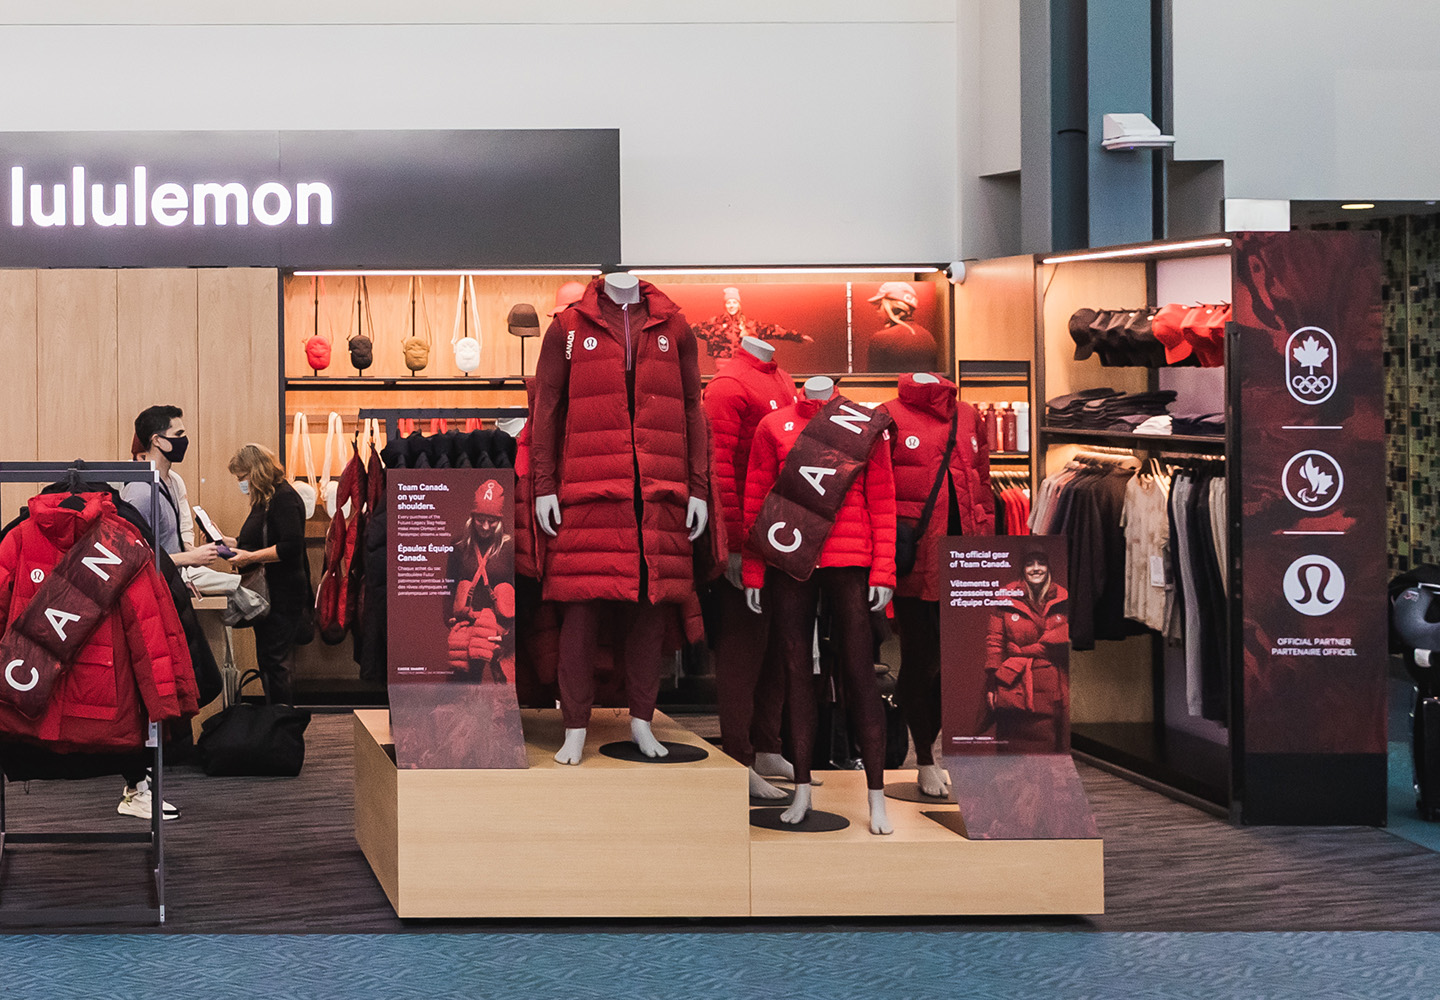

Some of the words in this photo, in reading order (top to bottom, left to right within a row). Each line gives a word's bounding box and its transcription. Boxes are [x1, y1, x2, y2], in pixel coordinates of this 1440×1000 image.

[11, 165, 333, 227] lululemon
[565, 330, 576, 360] CANADA
[767, 404, 872, 553] CAN
[397, 483, 418, 491] Team
[419, 483, 450, 492] Canada,
[408, 494, 426, 502] your
[397, 502, 436, 510] shoulders.
[397, 543, 427, 553] Épaulez
[428, 543, 454, 553] Équipe
[397, 554, 428, 562] Canada.
[992, 551, 1010, 560] gear
[949, 560, 958, 568] of
[959, 560, 980, 568] Team
[981, 560, 1012, 568] Canada.
[949, 579, 990, 588] Vêtements
[991, 580, 1000, 588] et
[950, 588, 994, 597] accessoires
[994, 588, 1025, 597] officiels
[950, 597, 983, 608] d'Équipe
[983, 598, 1015, 607] Canada.
[4, 541, 123, 692] CAN
[1276, 637, 1313, 646] OFFICIAL
[1314, 637, 1352, 646] PARTNER
[1271, 647, 1322, 656] PARTENAIRE
[1322, 647, 1358, 656] OFFICIEL
